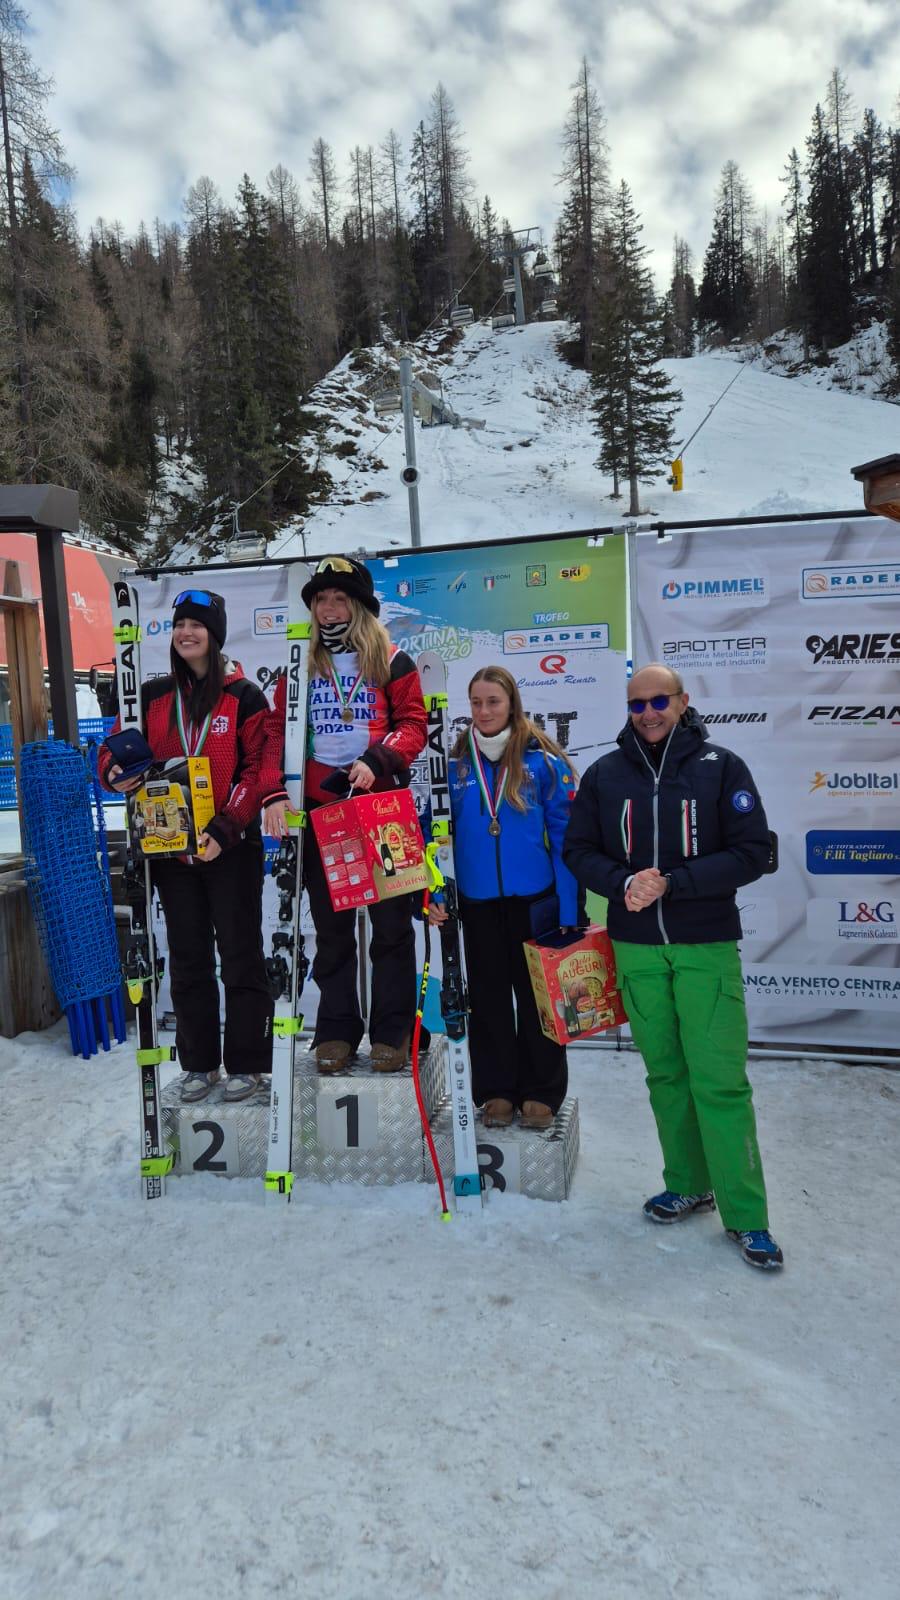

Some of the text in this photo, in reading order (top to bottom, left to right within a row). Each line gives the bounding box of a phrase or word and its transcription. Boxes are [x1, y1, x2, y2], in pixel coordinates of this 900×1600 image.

[561, 565, 581, 578] SKI
[684, 578, 764, 594] PIMMEL
[534, 611, 569, 623] TROFEO
[398, 626, 458, 651] ORTINA
[529, 630, 602, 643] RADER
[662, 637, 767, 654] BROTTER
[822, 632, 900, 660] ARIES
[287, 643, 301, 722] HEAD
[563, 674, 597, 684] Renato
[701, 712, 768, 725] GIAPURA
[807, 706, 900, 720] FIZAN
[316, 723, 355, 735] 2026
[826, 772, 899, 789] JobItal
[264, 852, 280, 861] F.ll
[824, 850, 846, 860] F.lli
[848, 850, 894, 862] Tagliaro
[838, 901, 895, 923] L&G
[741, 975, 900, 991] ANCA VENETO CENTRA
[756, 988, 847, 997] COOPERATIVO
[855, 991, 898, 999] ITALIA
[335, 1094, 359, 1148] 1
[192, 1120, 228, 1172] 2
